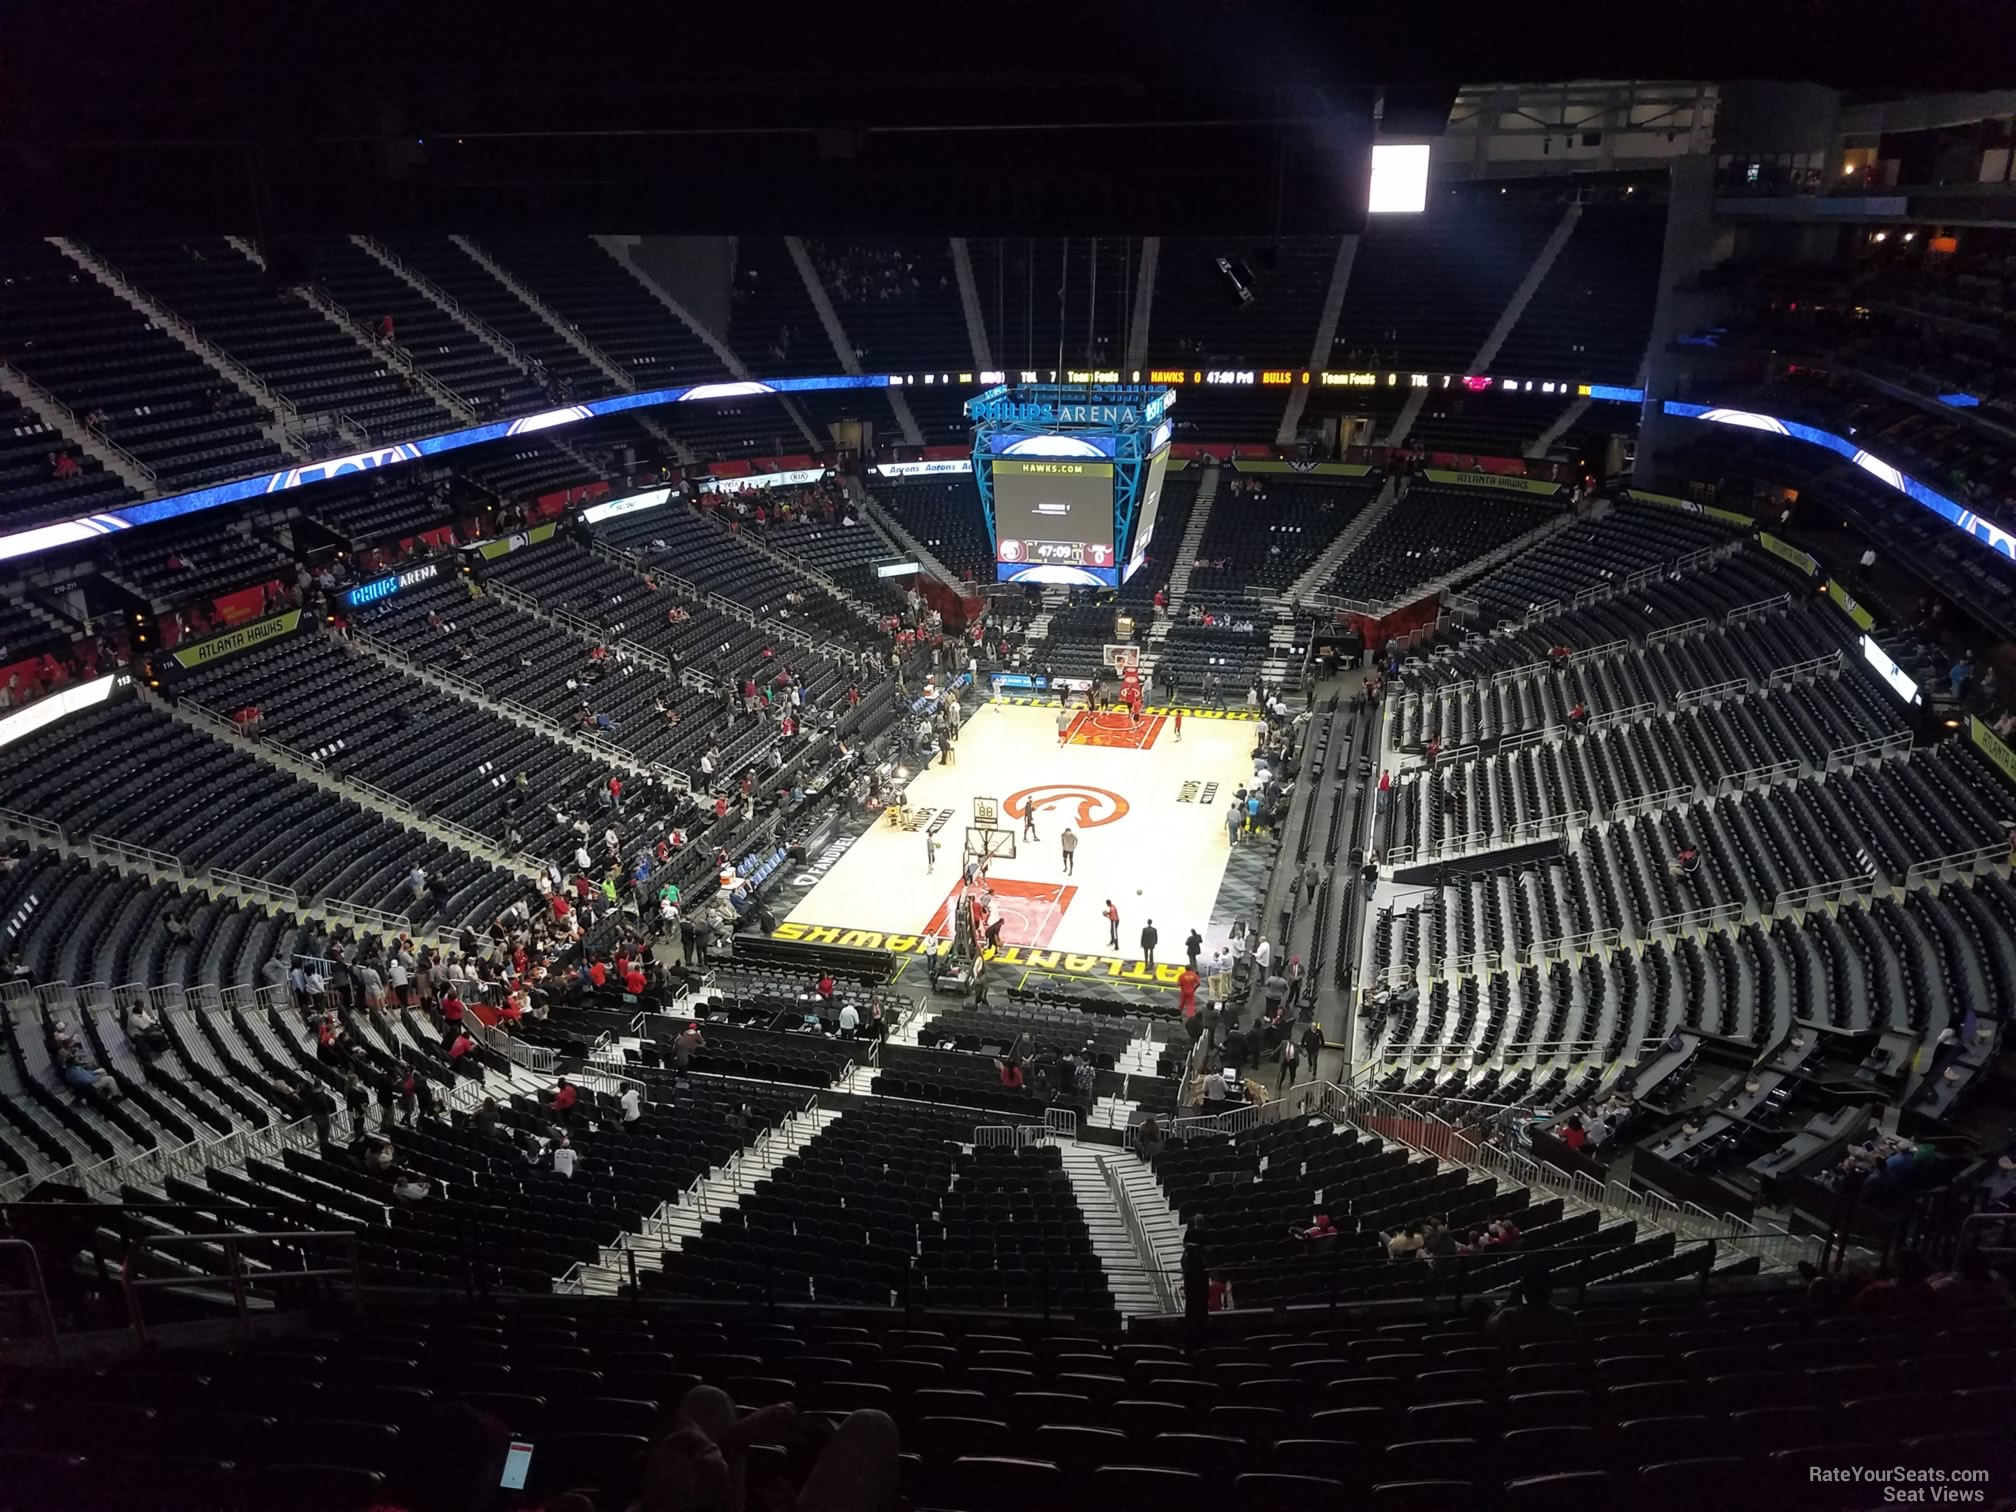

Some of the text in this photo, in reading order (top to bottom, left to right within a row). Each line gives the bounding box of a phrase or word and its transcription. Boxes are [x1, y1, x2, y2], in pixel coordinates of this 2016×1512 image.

[1151, 371, 1201, 383] HAWKS 0
[1263, 372, 1309, 383] BULLS 0
[972, 402, 1052, 421] PHILIPS
[1059, 406, 1134, 422] ARENA
[1022, 464, 1083, 473] HAWKS.COM
[1457, 474, 1529, 490] ATLANTA HAWKS
[1037, 544, 1071, 558] 47:09
[352, 565, 438, 605] PHILIPS ARENA
[199, 619, 283, 660] ATLANTA HAWKS
[117, 674, 131, 687] 113
[1982, 731, 2010, 768] ATLANTA
[807, 836, 857, 874] FANDUEL
